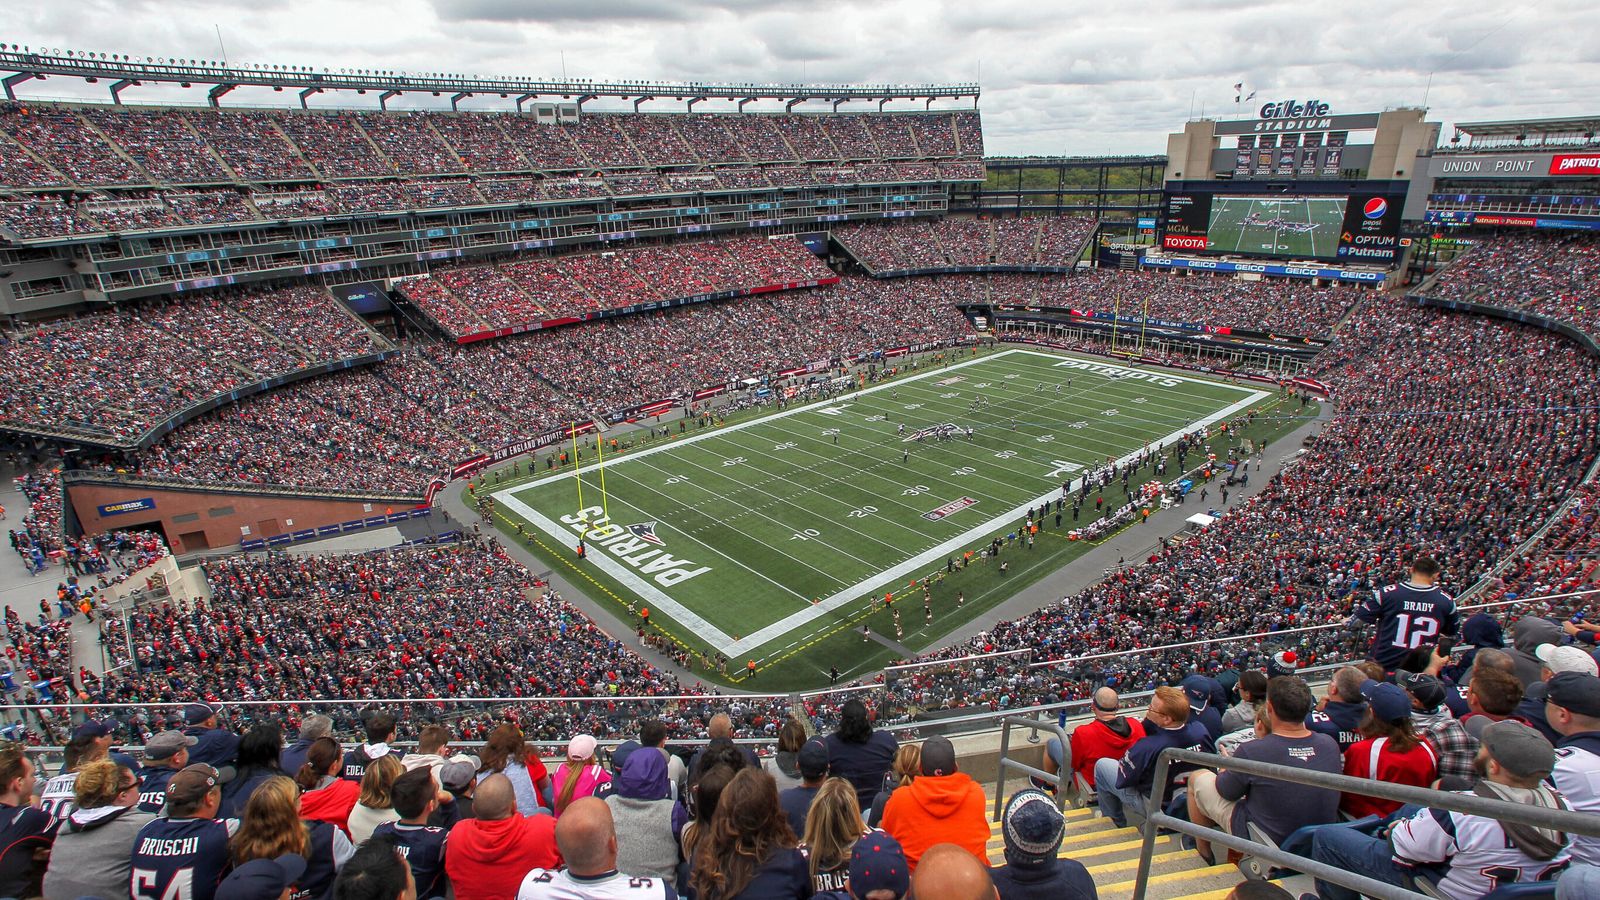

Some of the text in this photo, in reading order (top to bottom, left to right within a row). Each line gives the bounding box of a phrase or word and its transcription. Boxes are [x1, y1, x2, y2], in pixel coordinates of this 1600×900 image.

[1260, 100, 1329, 119] Gillette
[1254, 119, 1332, 131] STADIUM
[1443, 160, 1535, 172] UNION POINT
[1166, 225, 1189, 233] MGM
[1165, 237, 1205, 248] TOYOTA
[1355, 236, 1395, 245] OPTUM
[1348, 246, 1394, 257] Putnam
[1188, 260, 1217, 268] GEICO
[1235, 263, 1265, 272] GEICO
[1285, 267, 1318, 276] GEICO
[1340, 271, 1376, 280] GEICO
[1052, 360, 1184, 387] PATRIOTS
[494, 430, 564, 460] NEW ENGLAND PATRIOTS
[904, 485, 930, 496] 30
[850, 505, 878, 518] 20
[794, 528, 821, 541] 10
[560, 506, 713, 588] PATRIOTS
[1403, 600, 1434, 612] BRADY
[1391, 613, 1439, 649] 12
[138, 791, 166, 805] OTS
[138, 837, 199, 856] BRUSCHI
[130, 867, 194, 900] 54
